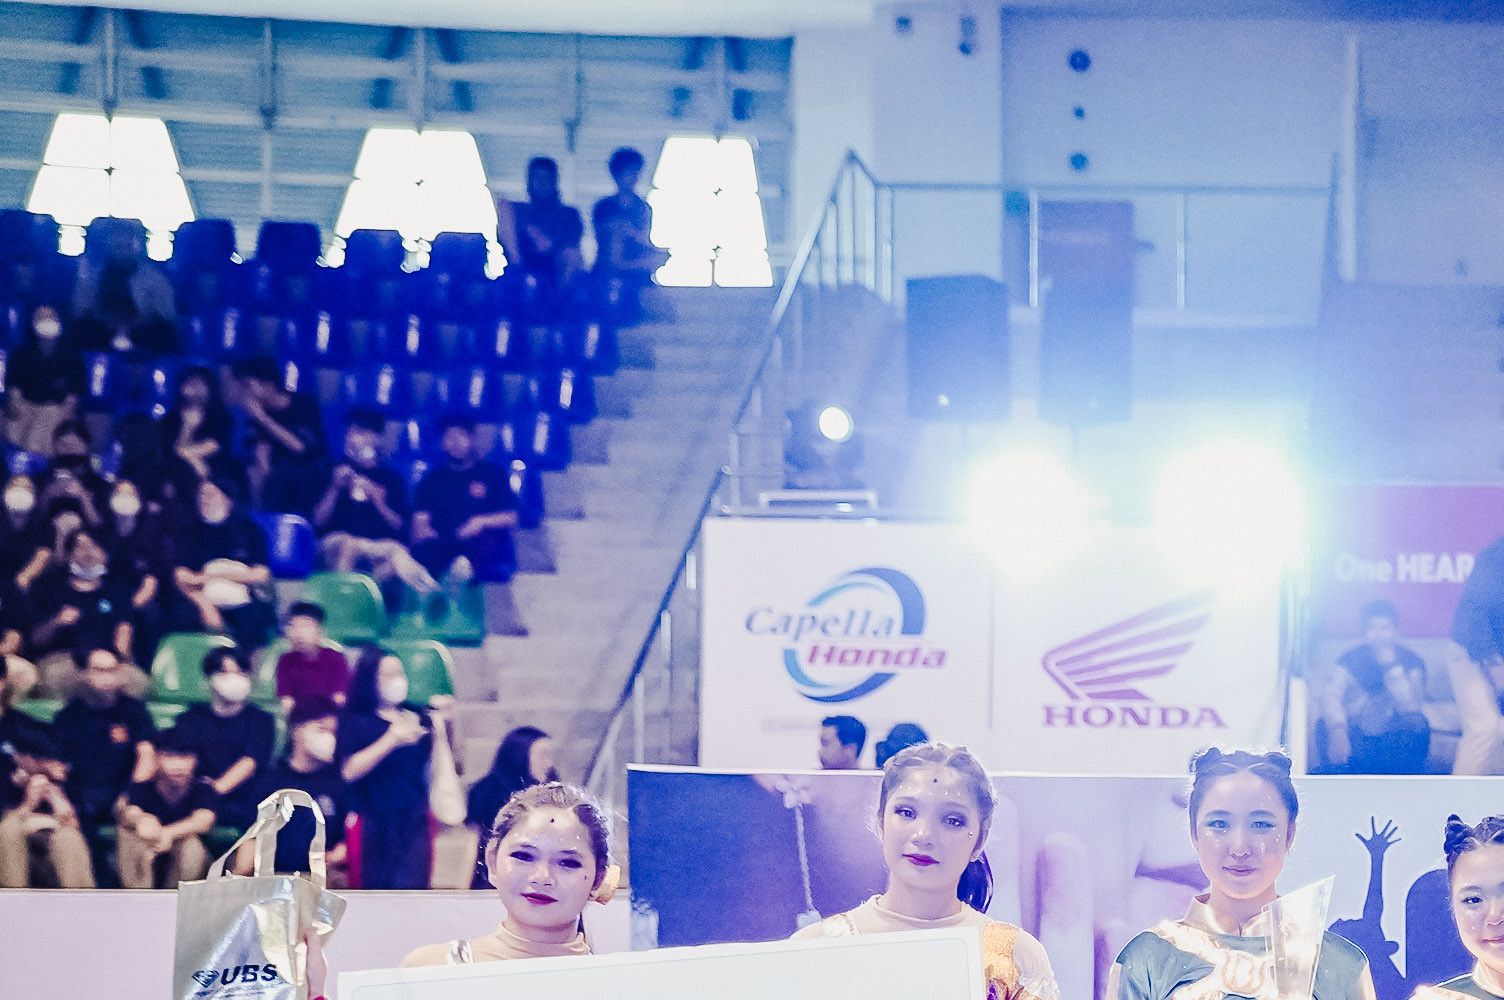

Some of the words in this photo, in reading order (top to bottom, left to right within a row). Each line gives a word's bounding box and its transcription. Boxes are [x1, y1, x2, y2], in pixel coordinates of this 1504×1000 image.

[1335, 552, 1394, 583] One
[1396, 552, 1475, 583] HEAR
[744, 605, 896, 642] Capella
[806, 643, 950, 671] Honda
[1041, 704, 1229, 731] HONDA
[220, 963, 278, 985] UBS
